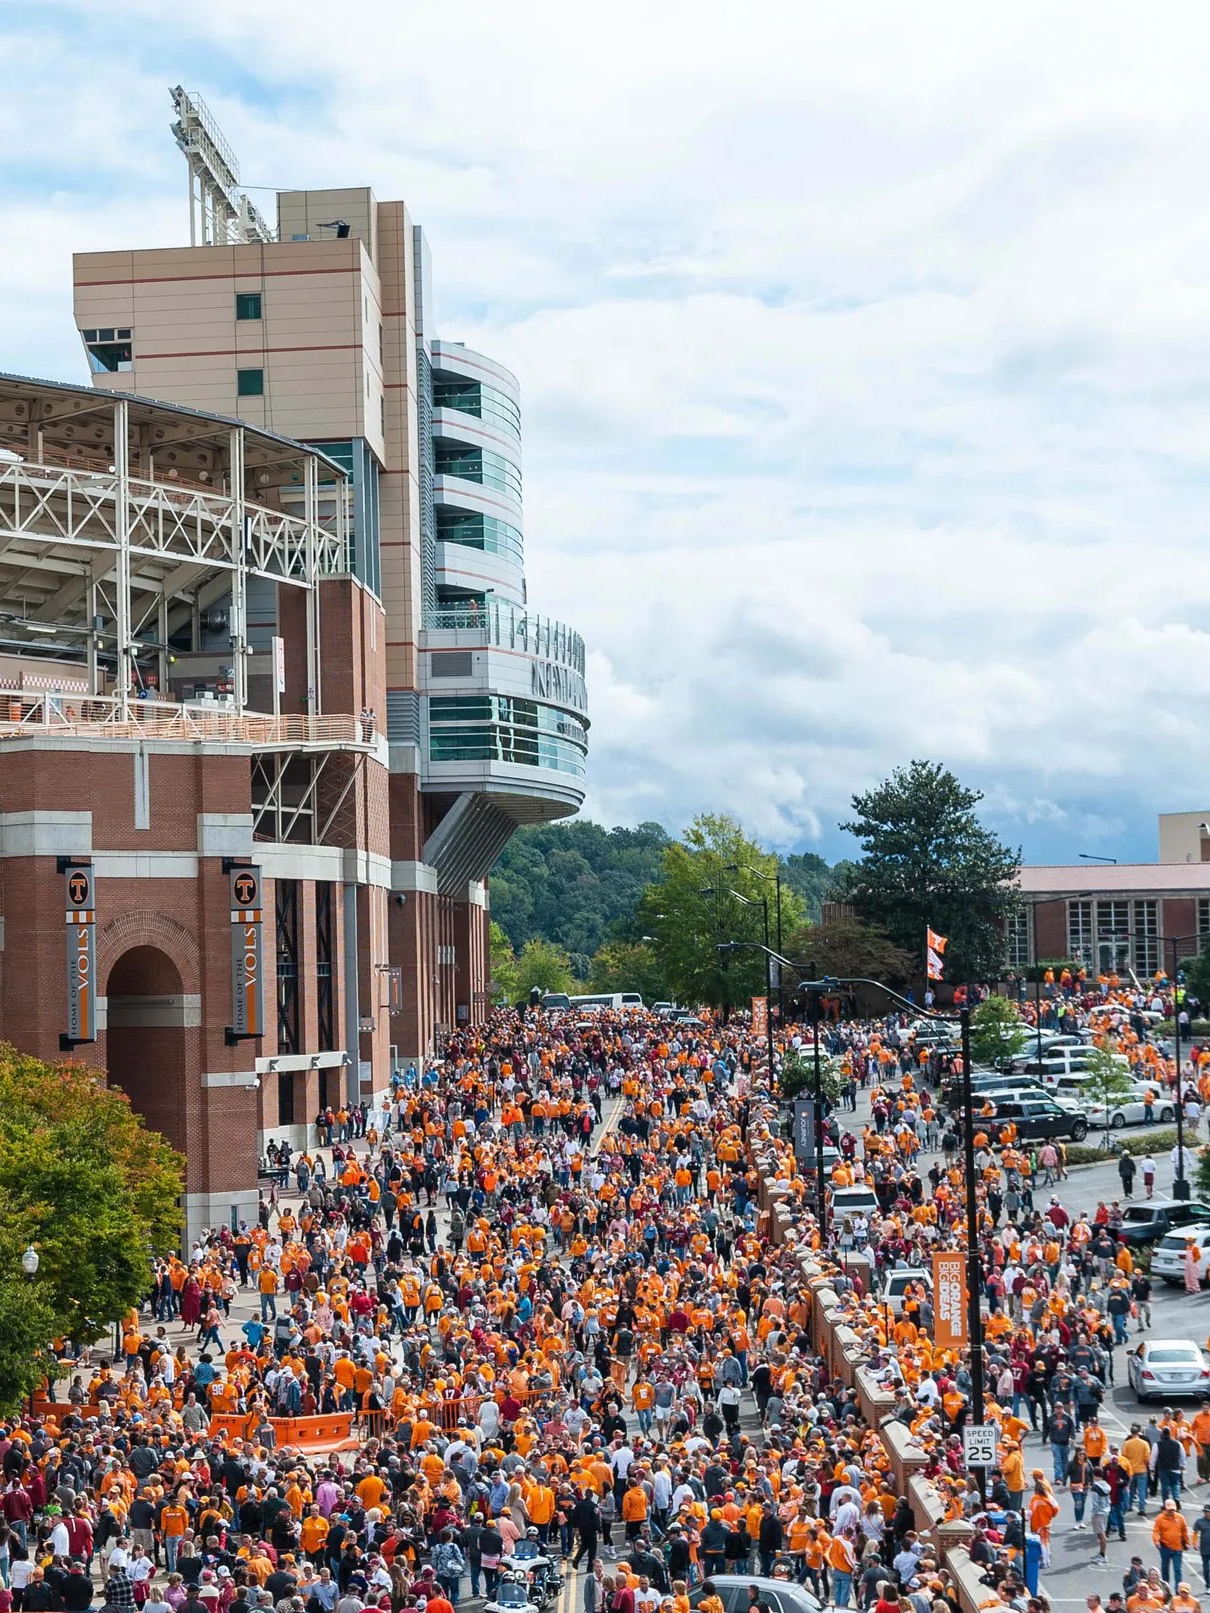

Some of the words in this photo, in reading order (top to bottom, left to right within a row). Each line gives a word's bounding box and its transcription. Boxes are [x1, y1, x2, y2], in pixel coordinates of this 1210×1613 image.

[71, 878, 86, 900] T
[237, 879, 253, 900] T
[77, 928, 89, 991] VOLS
[244, 927, 257, 988] VOLS
[71, 982, 77, 999] OF
[237, 981, 243, 996] OF
[445, 1389, 456, 1400] 17
[968, 1446, 993, 1461] 25
